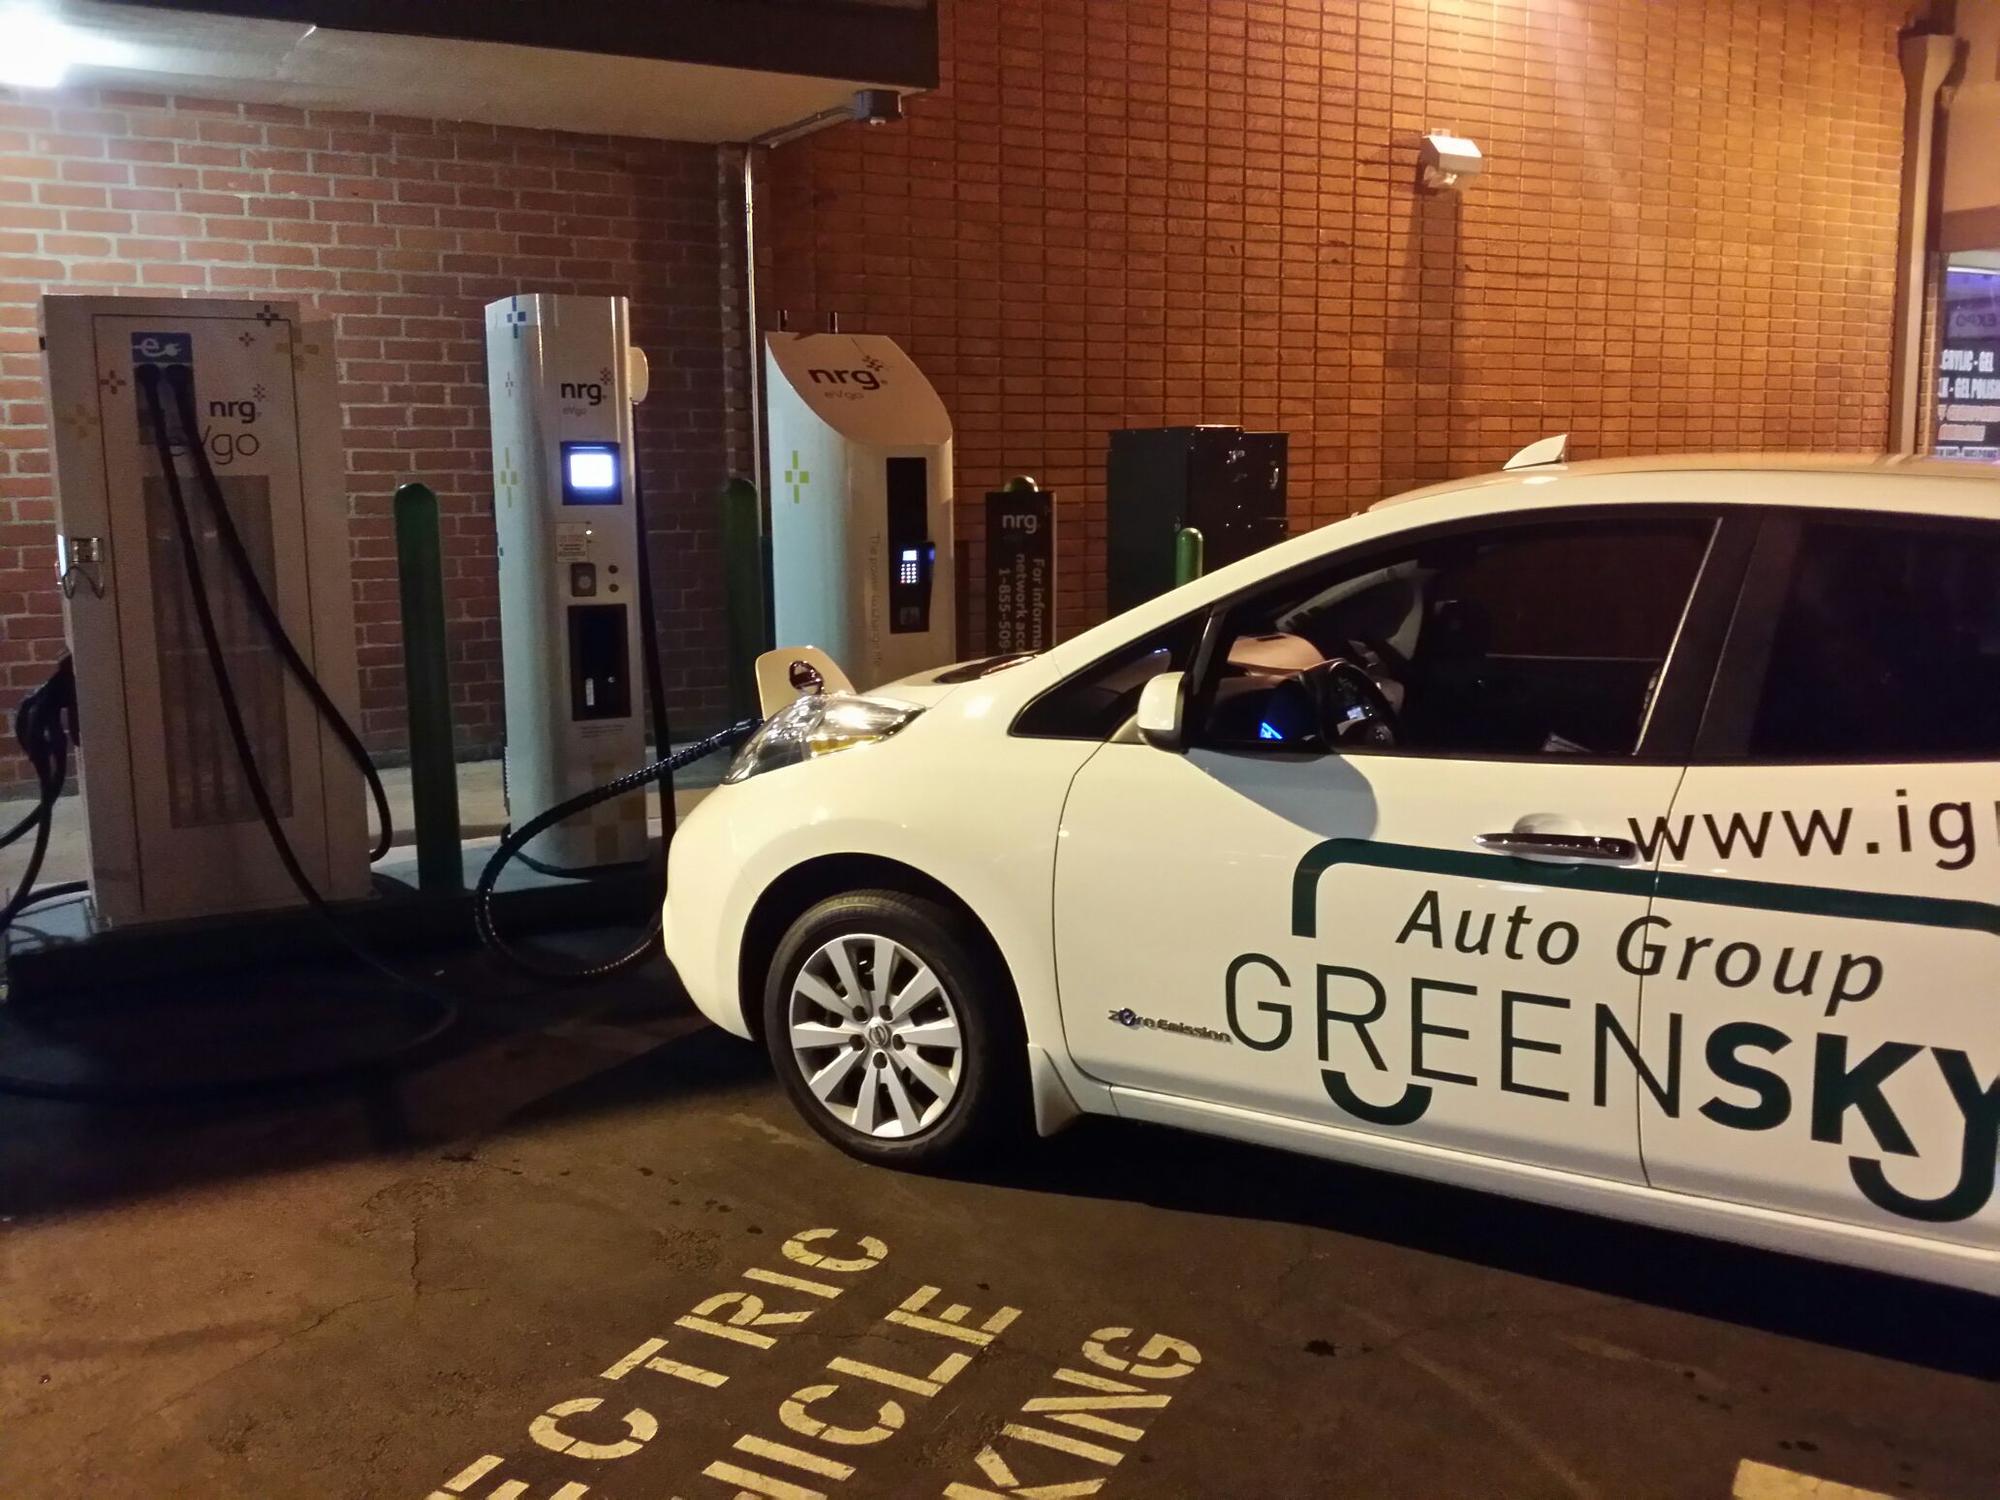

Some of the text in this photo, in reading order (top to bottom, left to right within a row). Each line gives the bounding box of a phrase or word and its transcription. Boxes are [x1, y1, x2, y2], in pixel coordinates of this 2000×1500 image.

[561, 383, 602, 406] nrg
[808, 369, 880, 390] nrg
[209, 401, 256, 424] nrg
[1002, 514, 1038, 534] nrg
[1015, 553, 1028, 618] network
[1032, 558, 1045, 651] For informa
[1627, 789, 2000, 871] www.ig
[1396, 890, 1884, 1017] Auto Group
[1225, 953, 2000, 1222] GREENSKY
